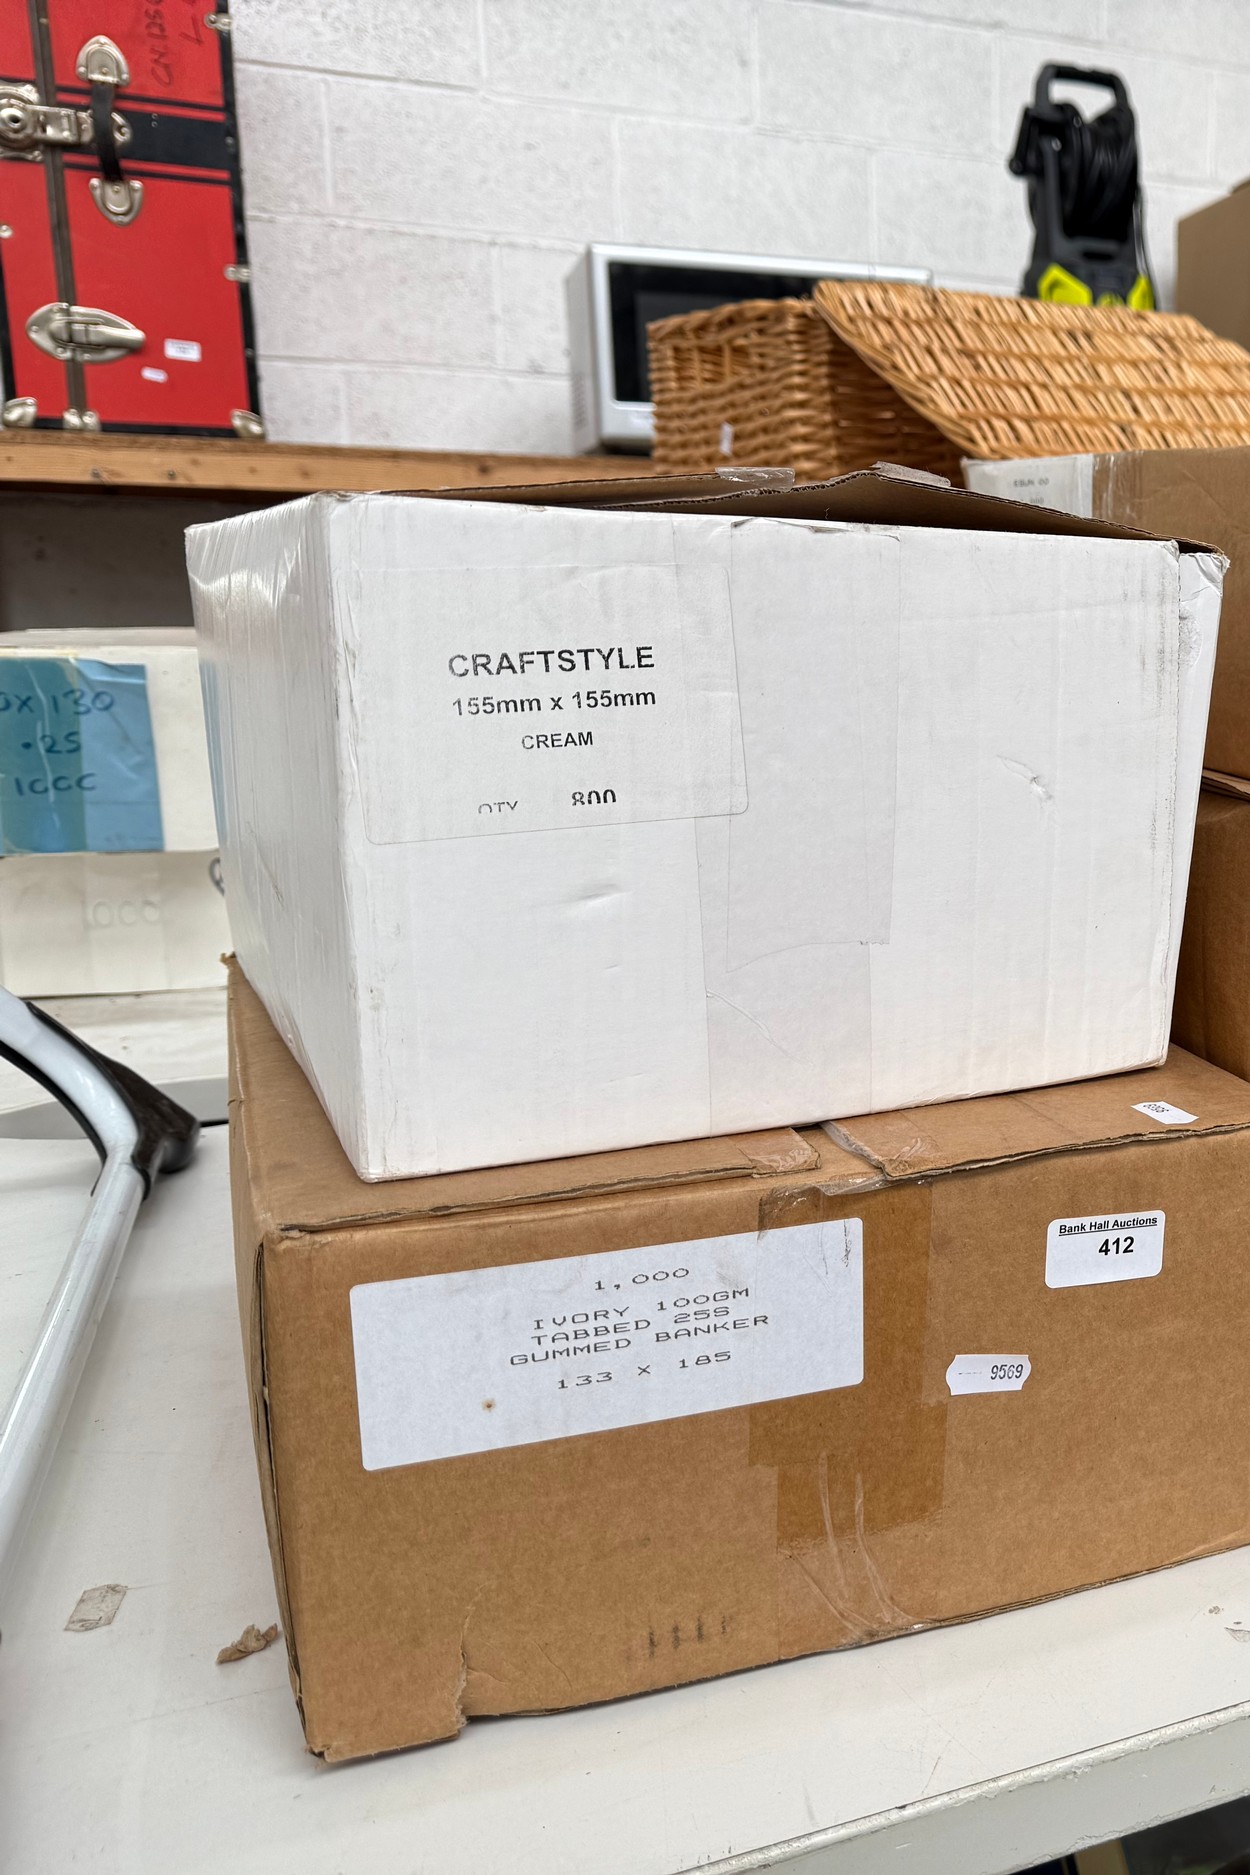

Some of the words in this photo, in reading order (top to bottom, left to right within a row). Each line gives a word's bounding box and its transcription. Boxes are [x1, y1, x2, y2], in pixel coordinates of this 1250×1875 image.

[448, 646, 655, 678] CRAFTSTYLE
[452, 694, 542, 716] 155mm
[550, 694, 564, 710] x
[572, 690, 656, 710] 155mm
[521, 731, 594, 750] CREAM
[1058, 1221, 1087, 1235] Bank
[1089, 1219, 1110, 1231] Hall
[1112, 1215, 1158, 1229] Auctions
[1098, 1236, 1135, 1256] 412
[593, 1267, 690, 1292] 1,000
[533, 1306, 631, 1330] IVORY
[657, 1287, 751, 1311] 100GM
[510, 1338, 632, 1366] GUMMED
[655, 1314, 770, 1343] BANKER
[531, 1319, 653, 1346] TABBED
[556, 1372, 614, 1390] 133
[678, 1350, 732, 1370] 185
[989, 1363, 1024, 1381] 9569
